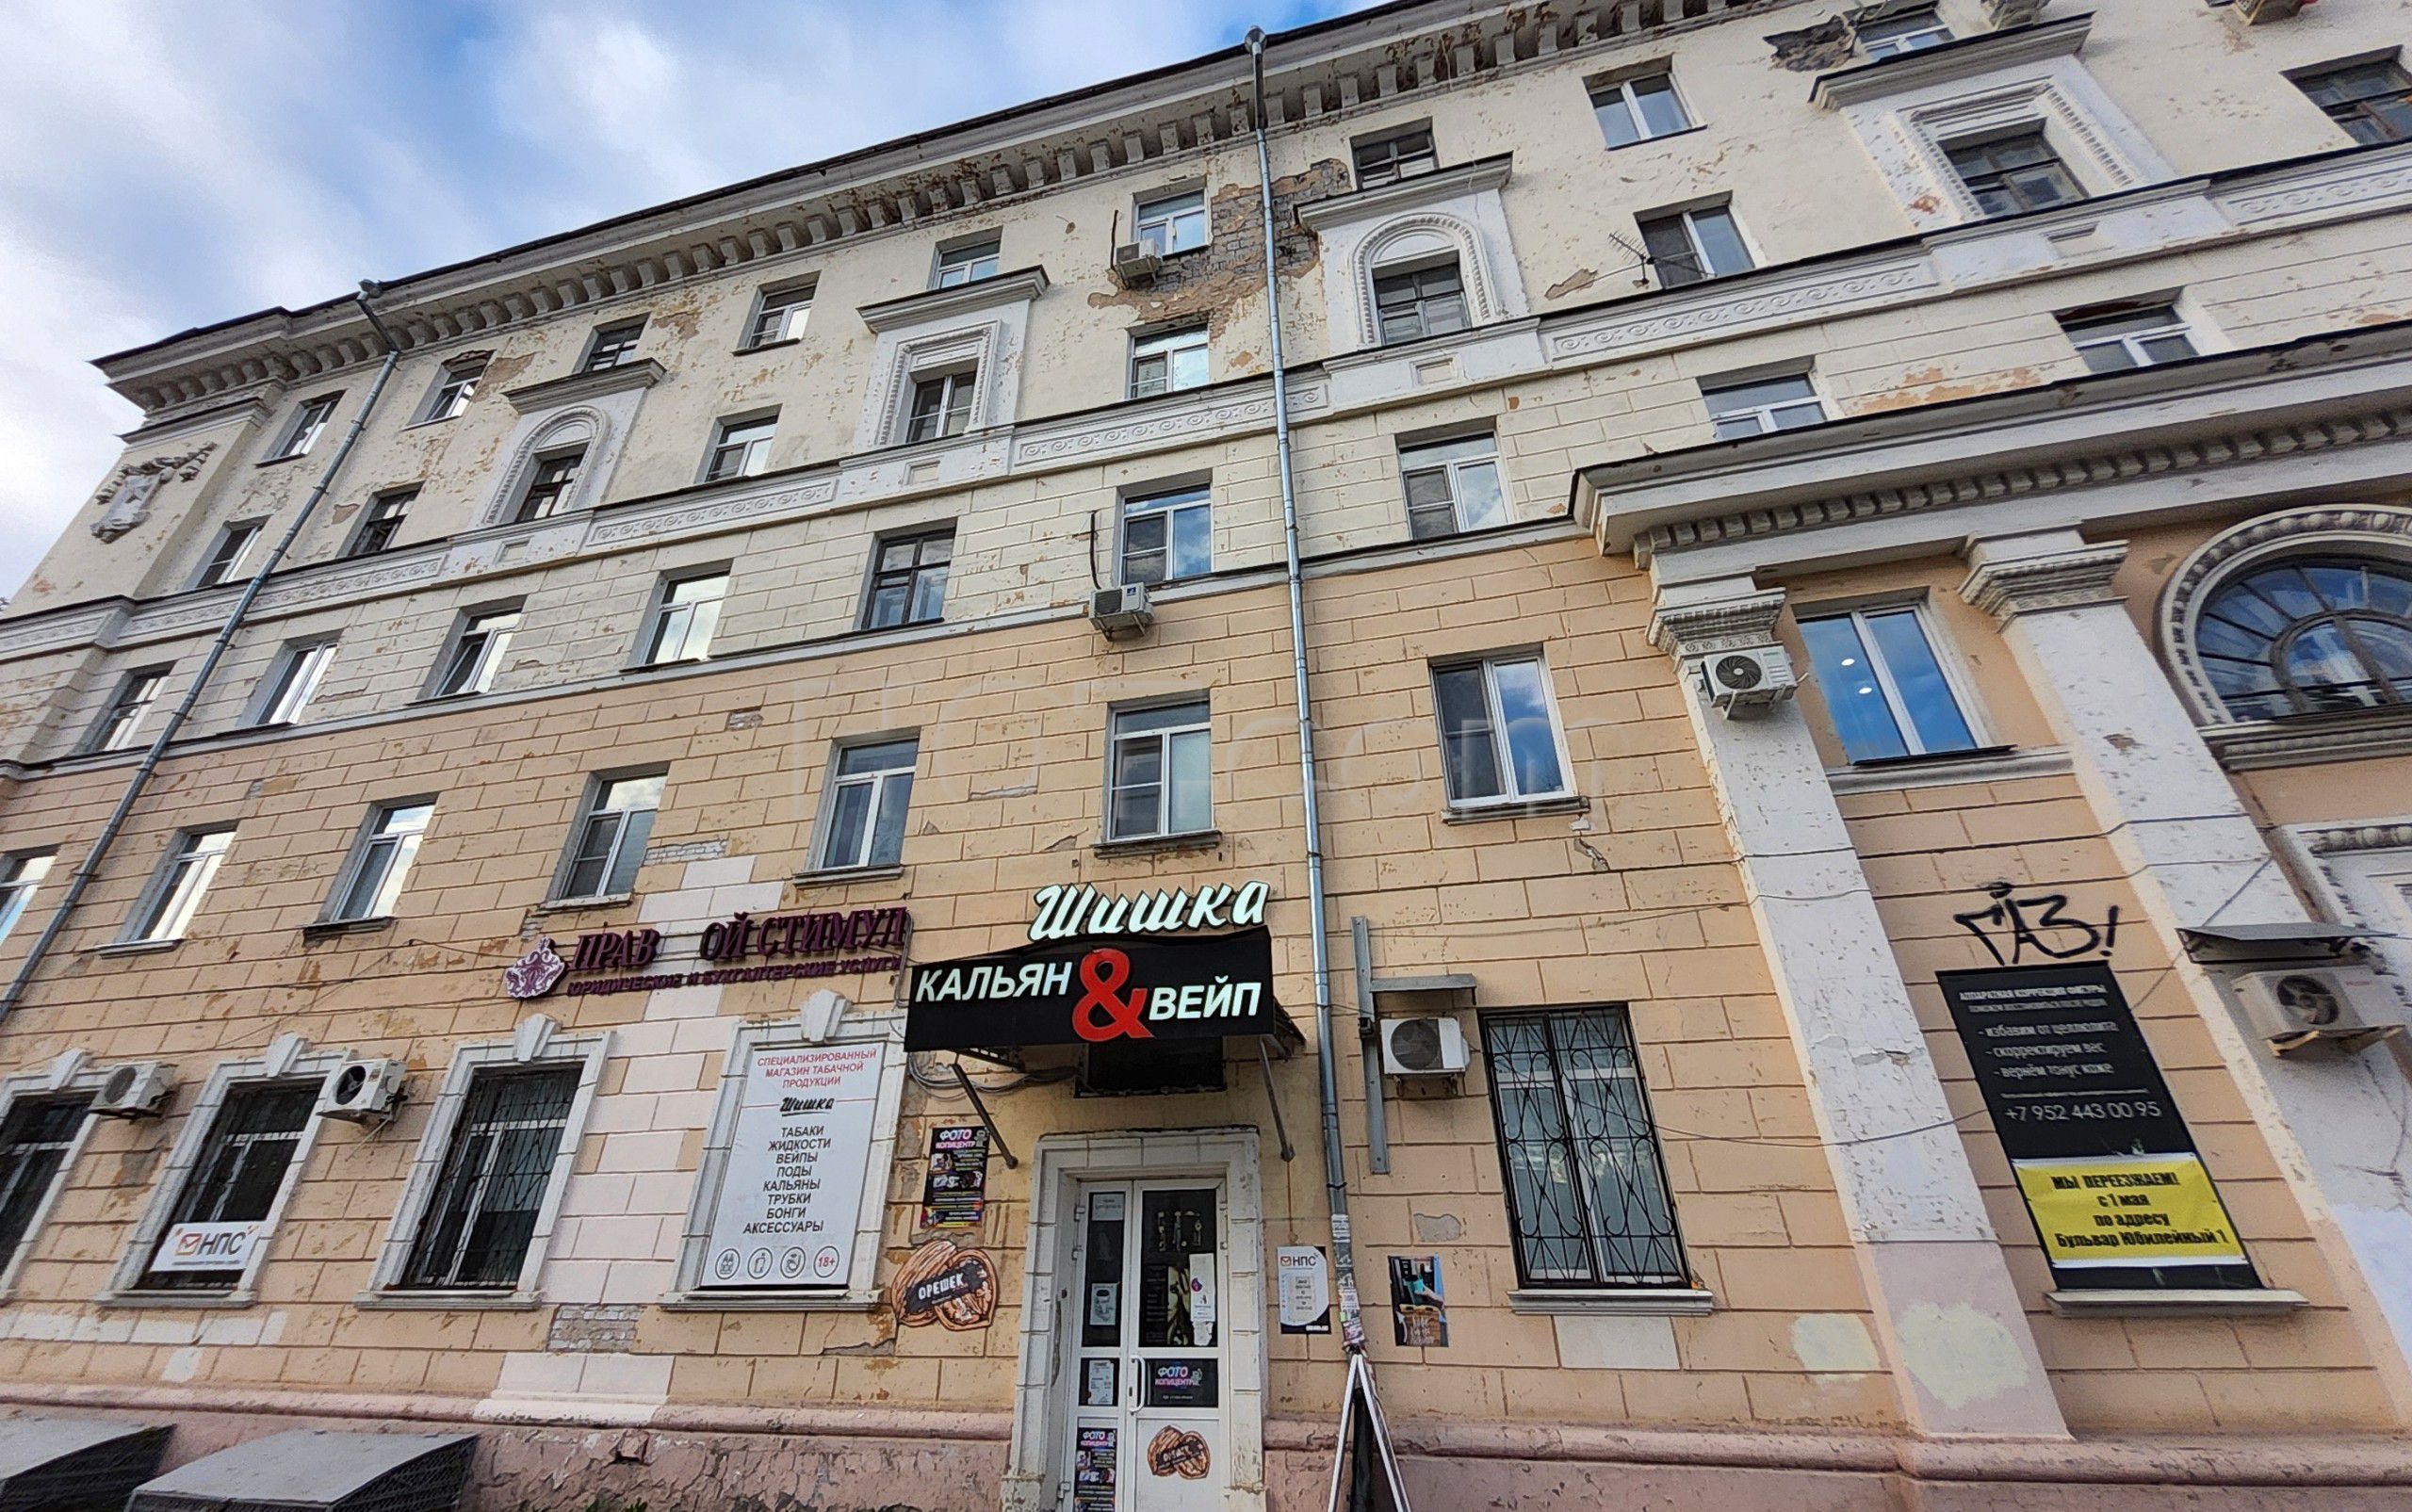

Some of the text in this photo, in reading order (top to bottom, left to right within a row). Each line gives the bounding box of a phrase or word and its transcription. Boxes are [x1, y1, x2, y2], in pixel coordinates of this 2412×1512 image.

[1027, 880, 1270, 942] Шишка
[757, 906, 908, 959] СТИМУЛ
[567, 955, 903, 997] ЮРИДИЧЕСКИЕ И БУХГАЛТЕРСКИЕ УСЛУГИ
[915, 948, 1262, 1041] КАЛЬЯН & ВЕЙП
[758, 1048, 877, 1066] СПЕЦИАЛИЗИРОВАННЫЙ
[765, 1062, 864, 1078] МАГАЗИН ТАБАЧНОЙ
[783, 1076, 841, 1089] ПРОДУКЦИИ
[779, 1097, 835, 1113] Шишка
[2006, 1100, 2161, 1122] +7 952 443 00 95
[781, 1125, 824, 1138] ТАБАКИ
[939, 1129, 972, 1141] ФОТО
[768, 1138, 831, 1152] ЖИДКОСТИ
[776, 1150, 818, 1164] ВЕЙПЫ
[776, 1165, 812, 1179] ПОДЫ
[763, 1179, 821, 1192] КАЛЬЯНЫ
[2051, 1172, 2180, 1190] МЫ ПЕРЕЕЗЖАЕМ!
[768, 1193, 811, 1205] ТРУБКИ
[2097, 1194, 2151, 1207] с 1 мая
[767, 1207, 807, 1219] БОНГИ
[2093, 1213, 2171, 1227] по адресу
[743, 1220, 823, 1234] АКСЕССУАРЫ
[197, 1231, 246, 1255] НПС
[2054, 1228, 2229, 1249] Бульвар Юбилейный 1
[818, 1256, 836, 1268] 18+
[1293, 1255, 1317, 1267] НПС
[918, 1273, 964, 1300] ОРЕШЕК
[1157, 1366, 1188, 1377] ФОТО
[1083, 1430, 1105, 1440] ФОТО
